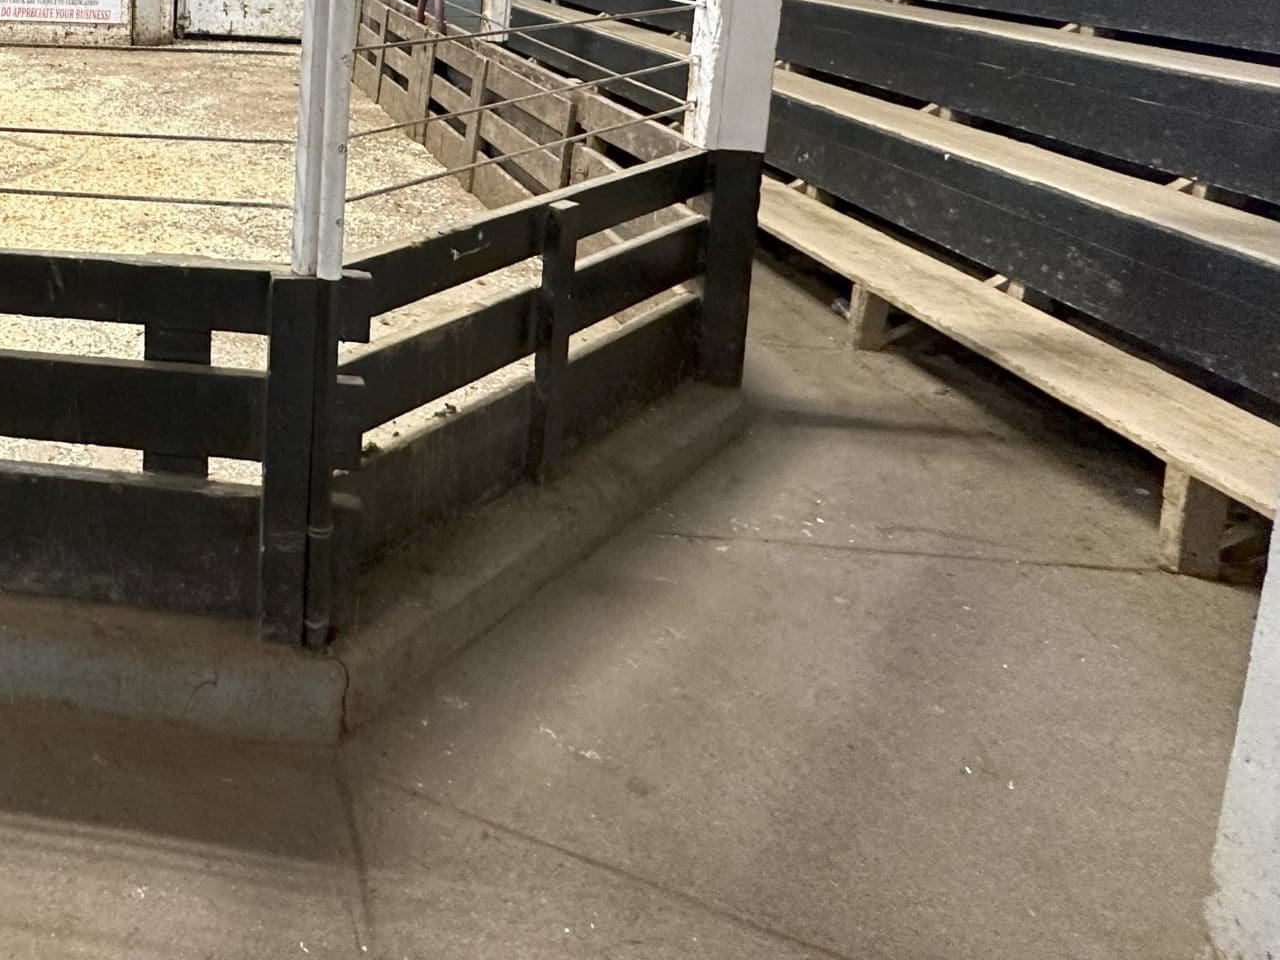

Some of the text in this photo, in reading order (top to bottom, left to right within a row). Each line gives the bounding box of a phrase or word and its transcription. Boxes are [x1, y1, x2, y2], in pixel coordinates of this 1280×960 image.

[0, 7, 12, 17] DO
[12, 7, 54, 19] APPRECIATE
[55, 8, 75, 19] YOUR
[75, 9, 112, 20] BUSINESS!
